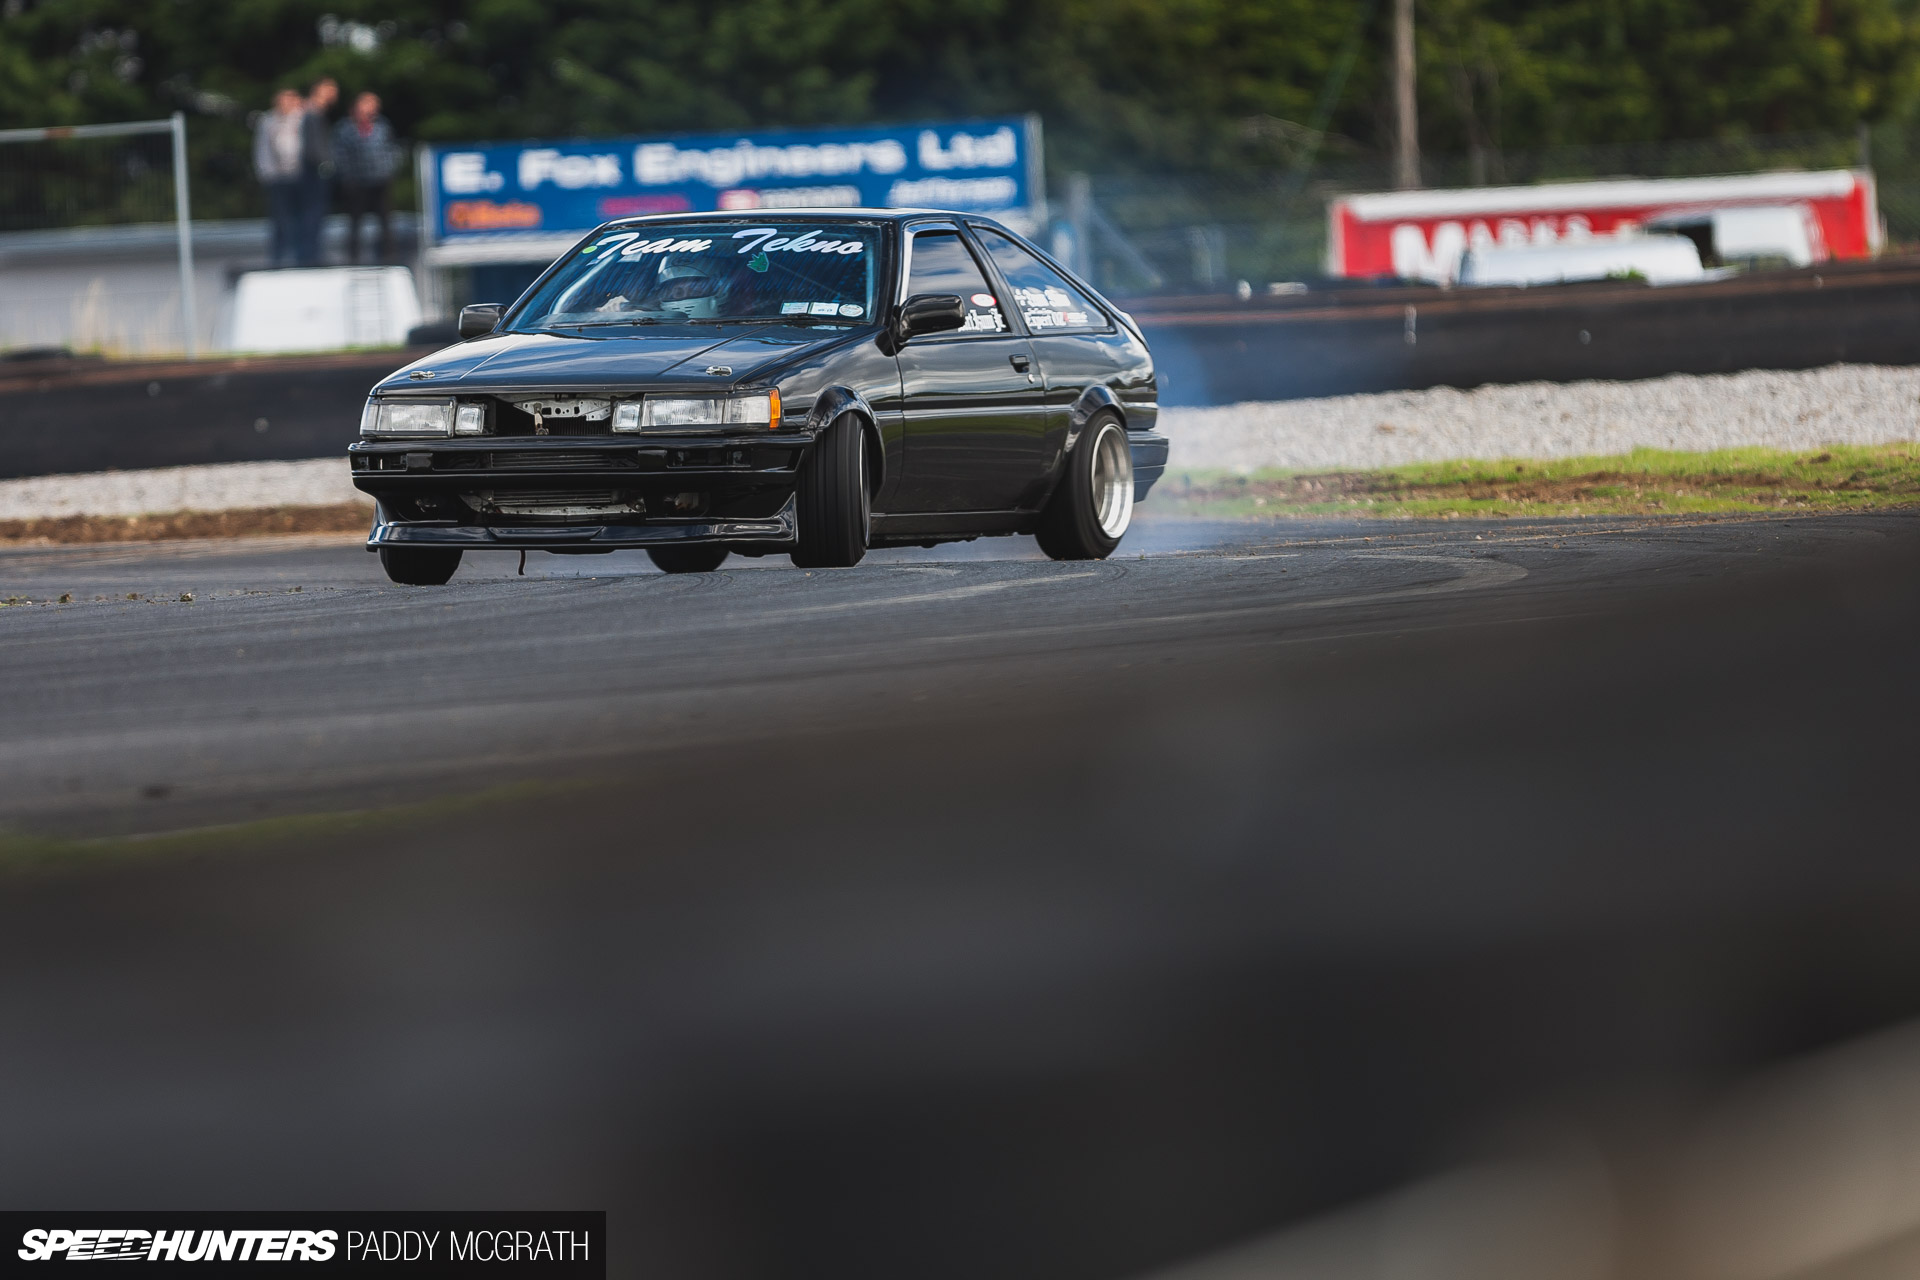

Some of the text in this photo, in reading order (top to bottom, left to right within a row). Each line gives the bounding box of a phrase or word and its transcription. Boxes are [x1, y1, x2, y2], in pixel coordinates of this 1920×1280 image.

[442, 127, 1017, 193] E. Fox Engineers Ltd
[596, 228, 863, 259] Team Tekno
